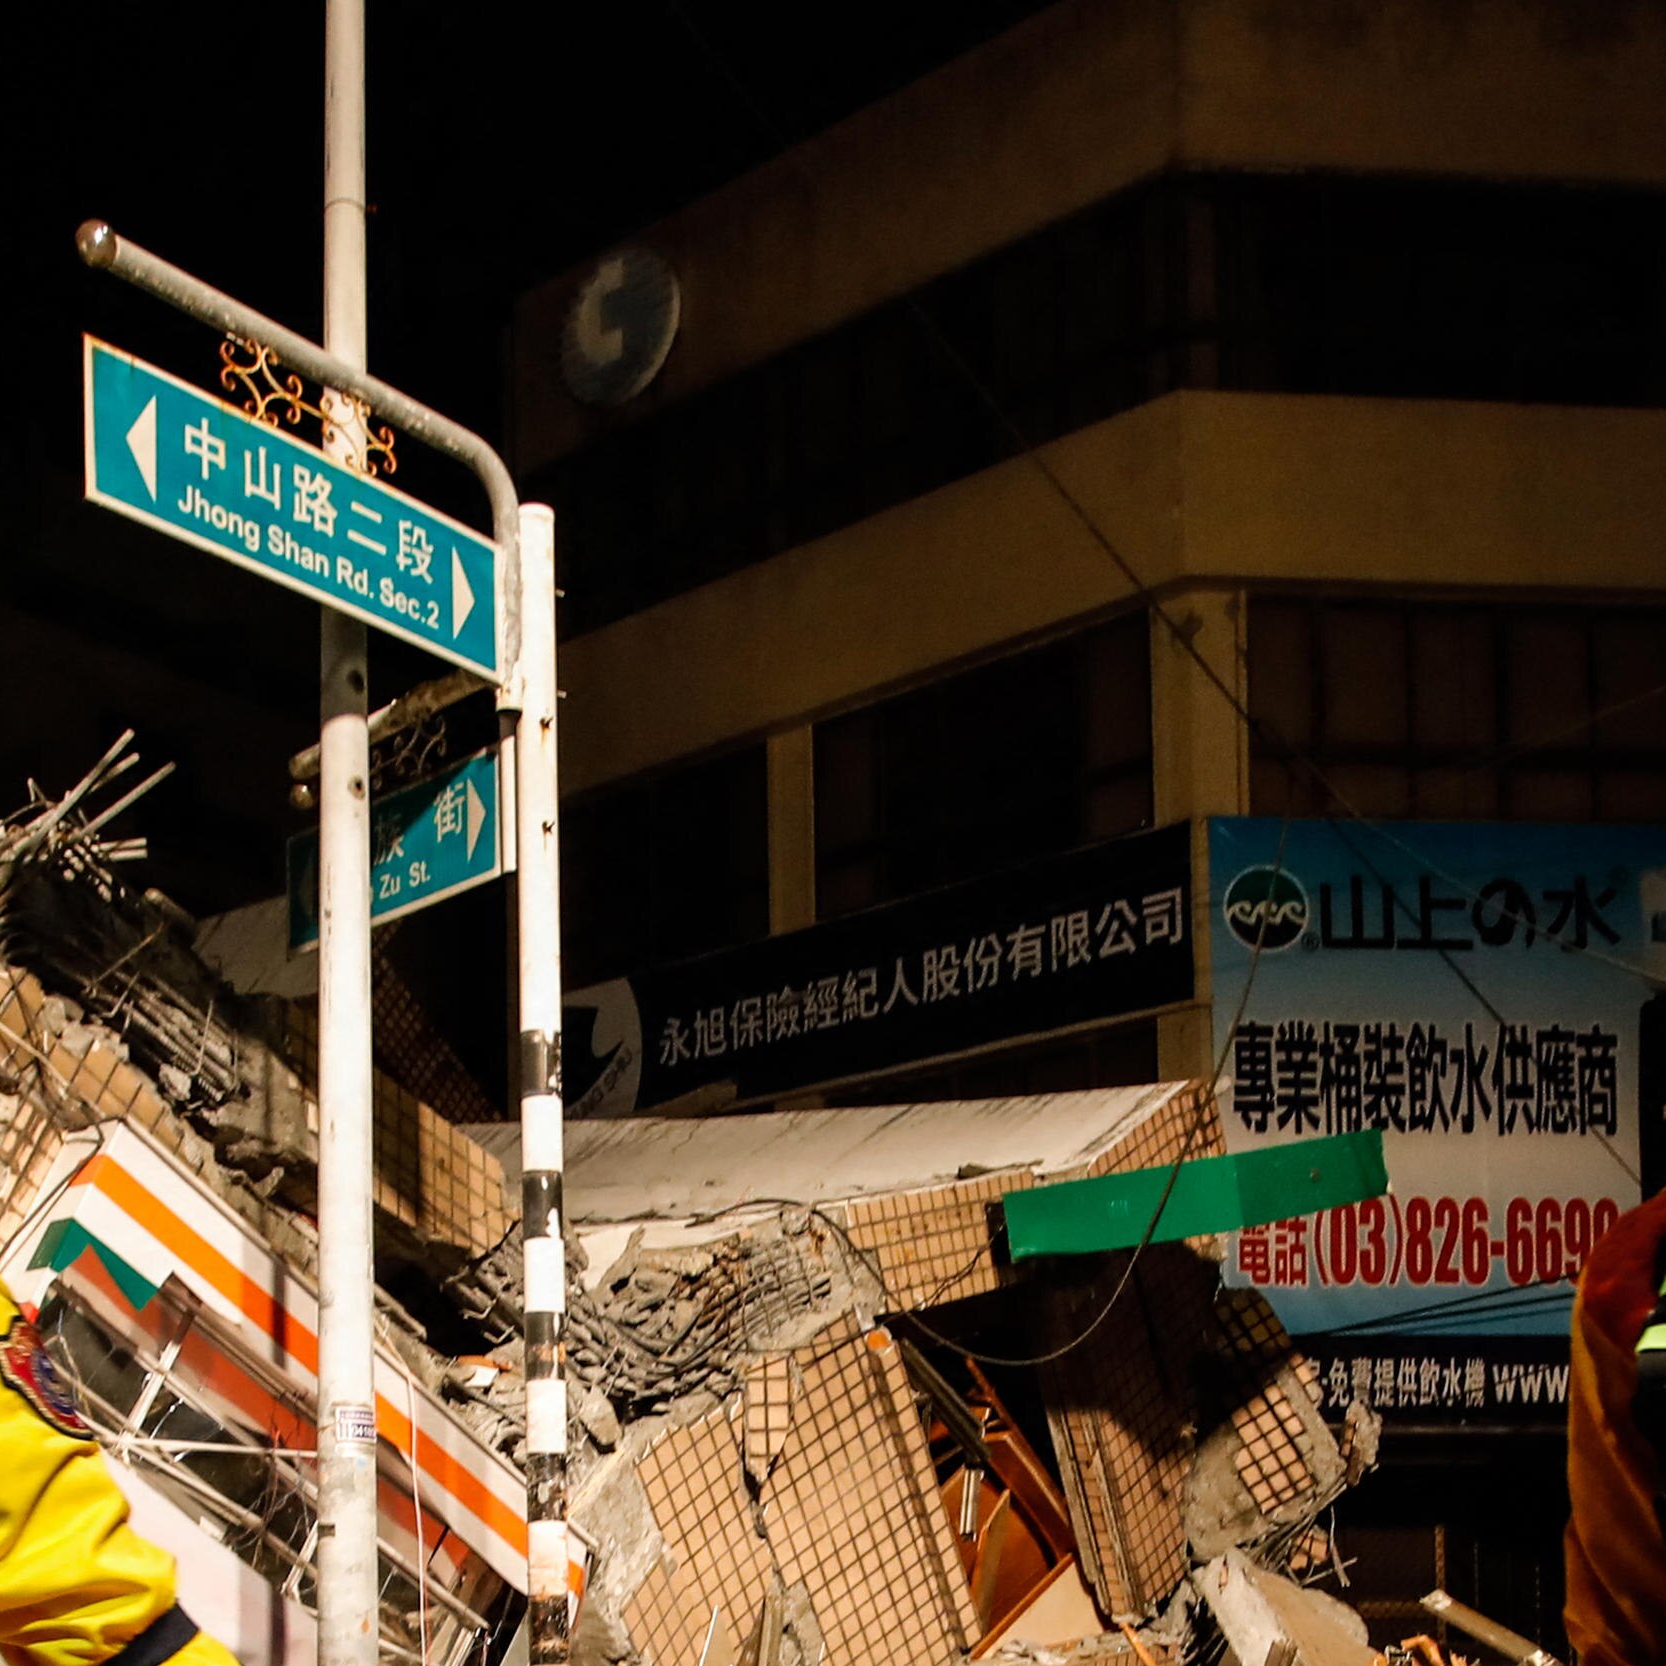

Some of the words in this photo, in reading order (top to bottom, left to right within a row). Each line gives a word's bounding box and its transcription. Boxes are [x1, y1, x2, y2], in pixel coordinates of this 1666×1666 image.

[178, 485, 260, 553] Jhong
[268, 527, 330, 578] Shan
[336, 558, 375, 600] Rd.
[379, 577, 440, 631] Sec.2
[184, 417, 434, 584] 中山路二段
[379, 874, 401, 900] Zu
[408, 859, 431, 888] St.
[1319, 874, 1621, 952] 山上の水
[659, 886, 1185, 1068] 永旭保險經紀人股份有限公司
[1232, 1020, 1618, 1136] 專業桶裝飲水供應商
